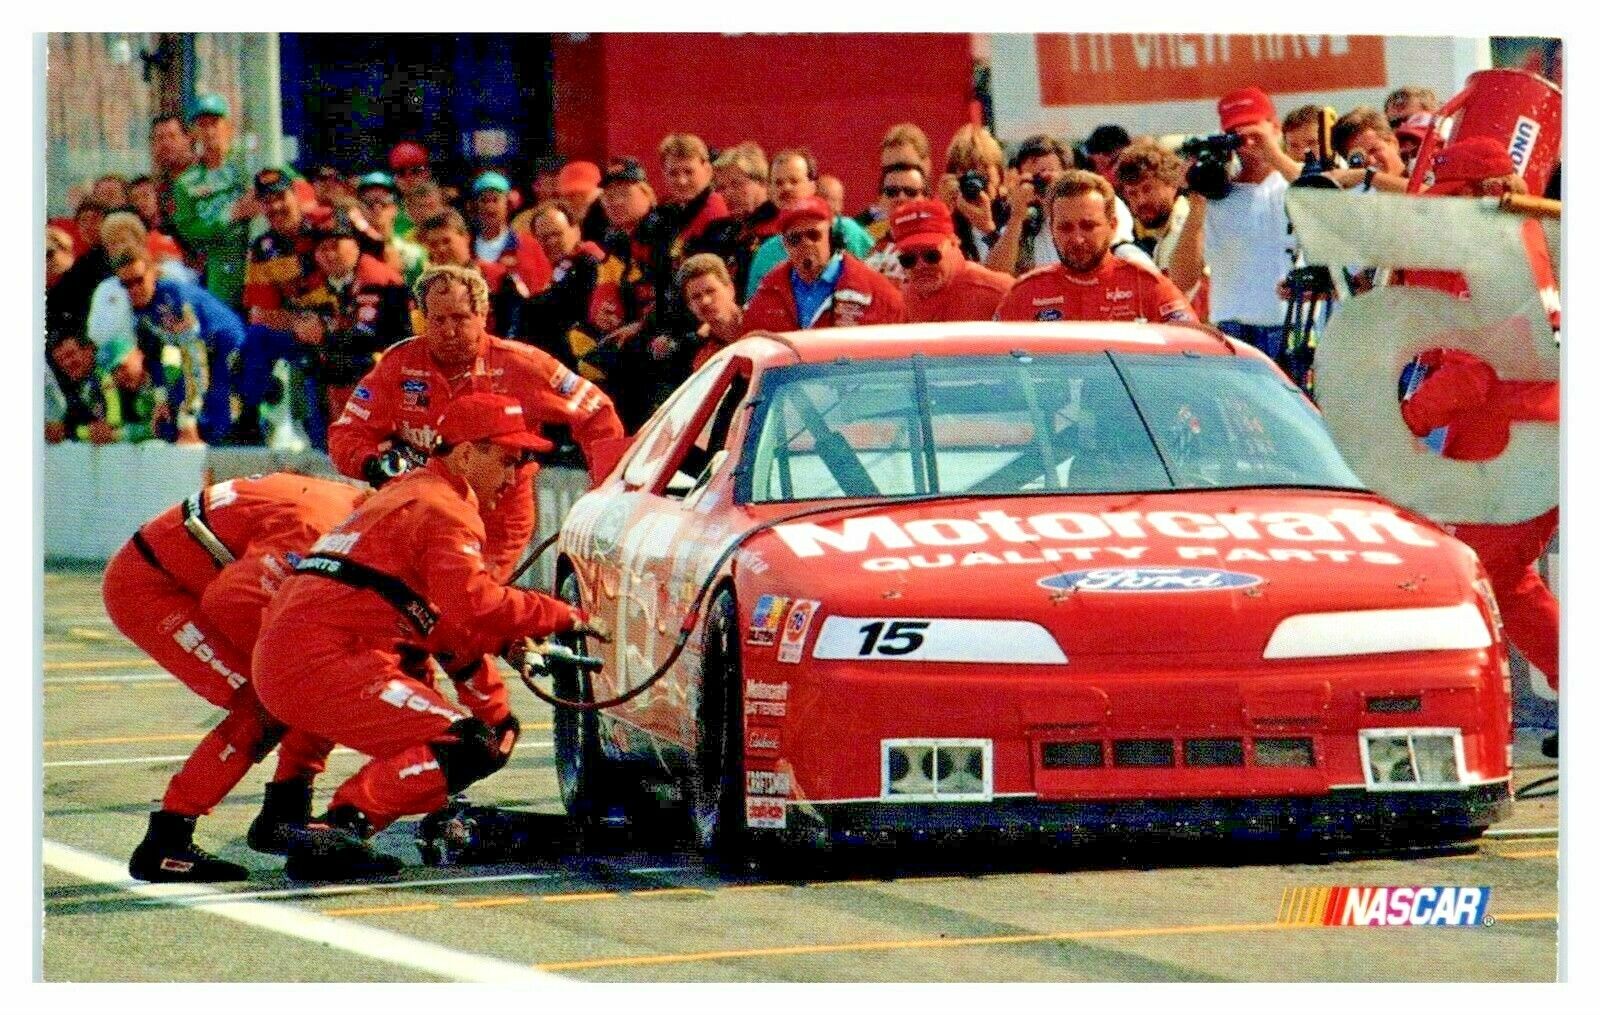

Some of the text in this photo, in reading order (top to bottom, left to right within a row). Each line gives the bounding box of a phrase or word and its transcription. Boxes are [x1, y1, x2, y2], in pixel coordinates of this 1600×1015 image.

[774, 508, 1436, 558] Motorcraft
[862, 546, 1402, 571] QUALITY PARTS
[859, 621, 930, 656] 15
